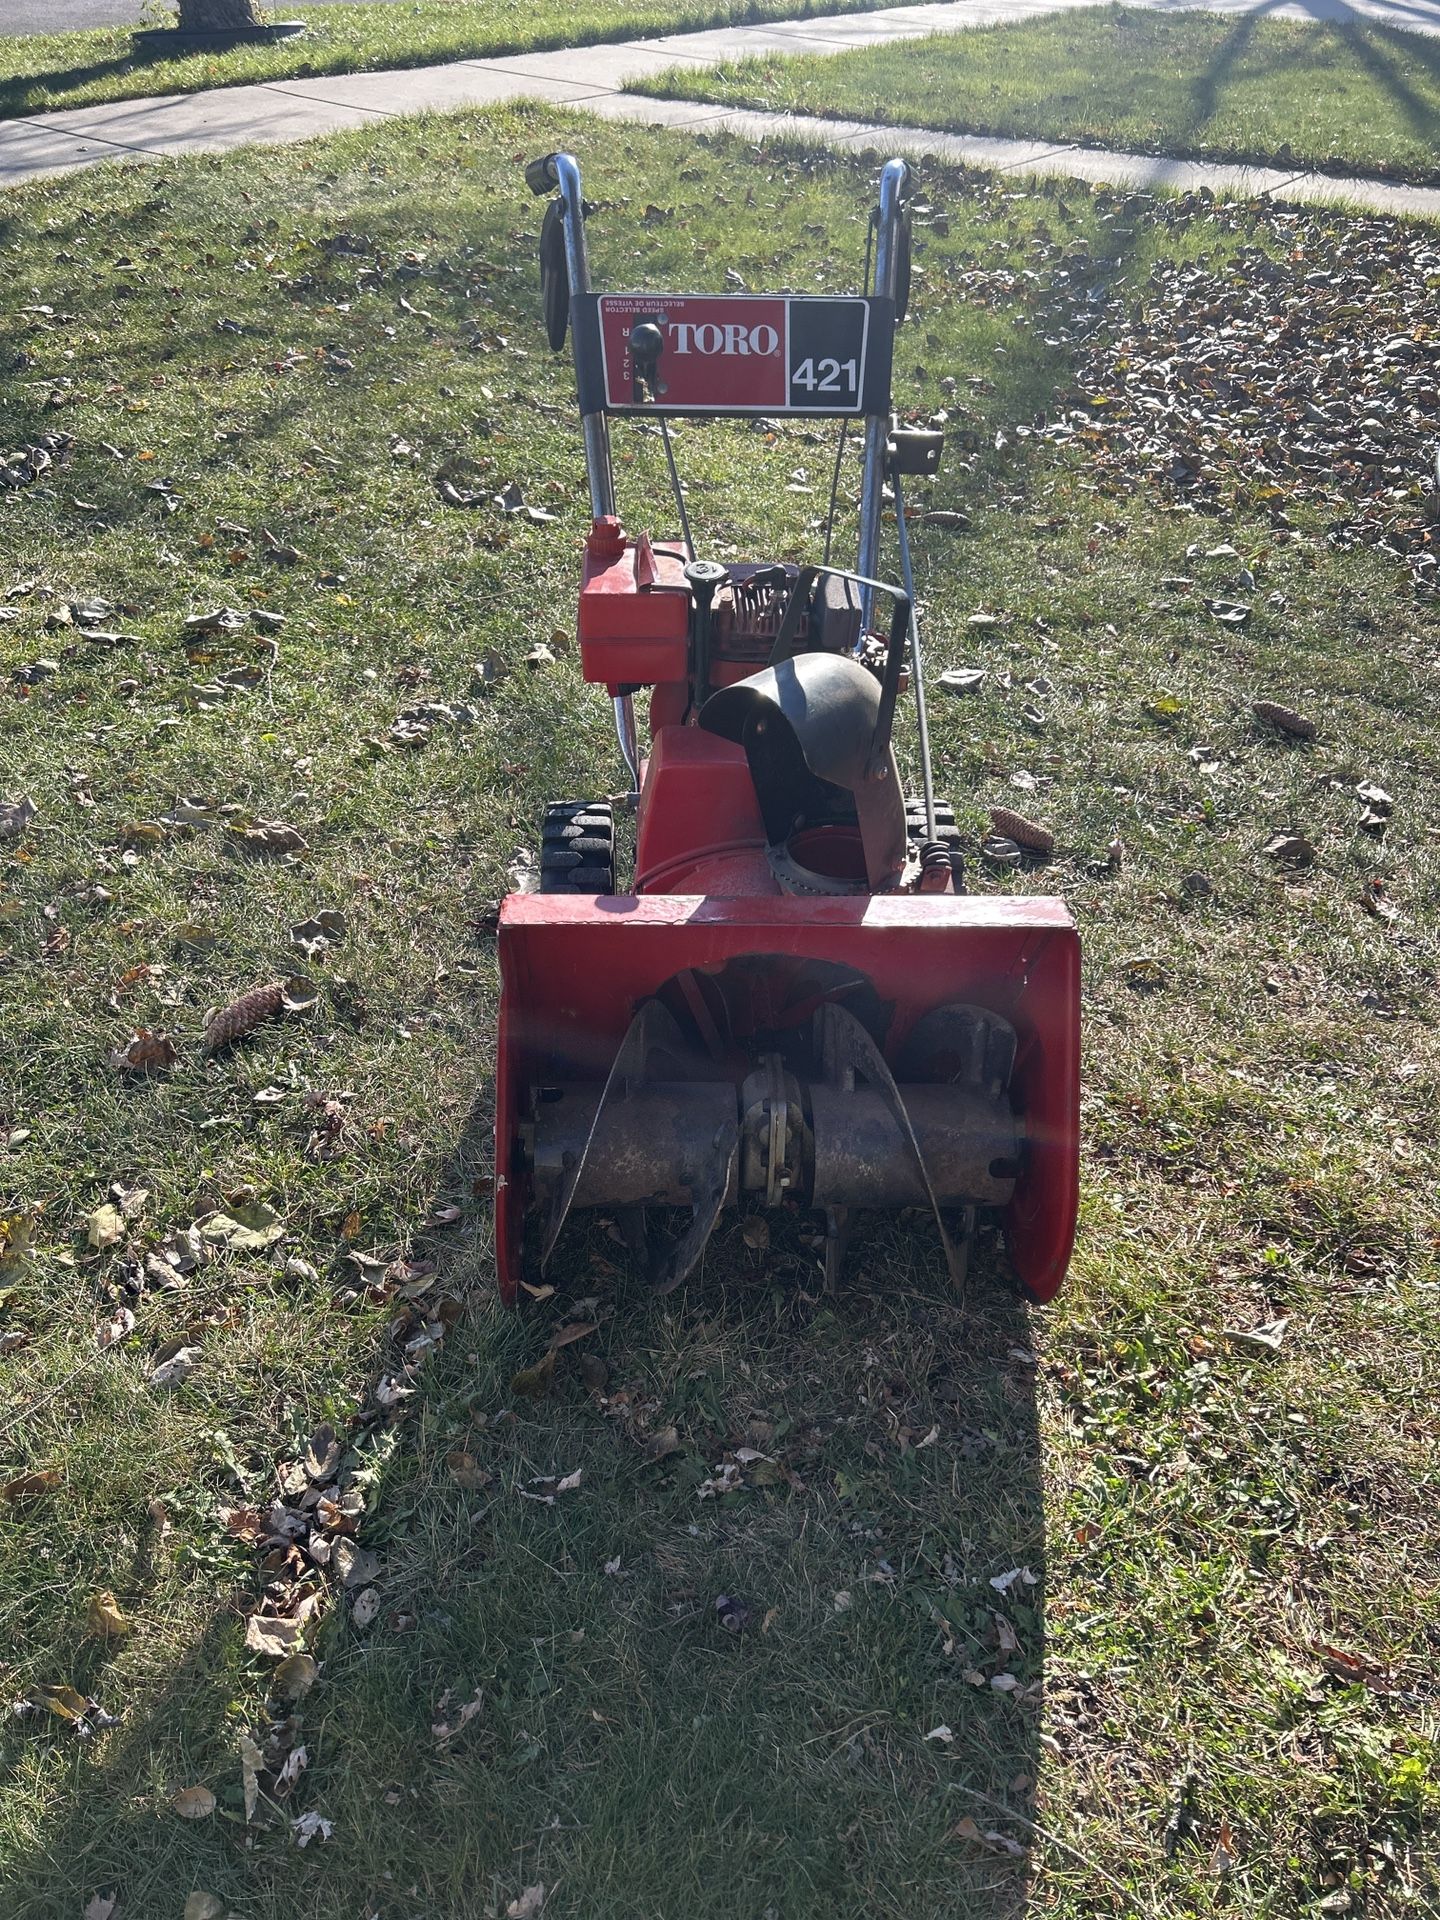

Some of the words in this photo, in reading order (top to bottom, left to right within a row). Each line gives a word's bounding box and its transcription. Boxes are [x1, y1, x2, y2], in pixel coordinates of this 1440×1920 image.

[606, 299, 634, 307] VITESSE
[622, 327, 630, 337] R
[669, 323, 778, 356] TORO
[625, 346, 630, 356] 1
[623, 359, 630, 368] 2
[623, 371, 630, 381] 3
[792, 358, 857, 391] 421
